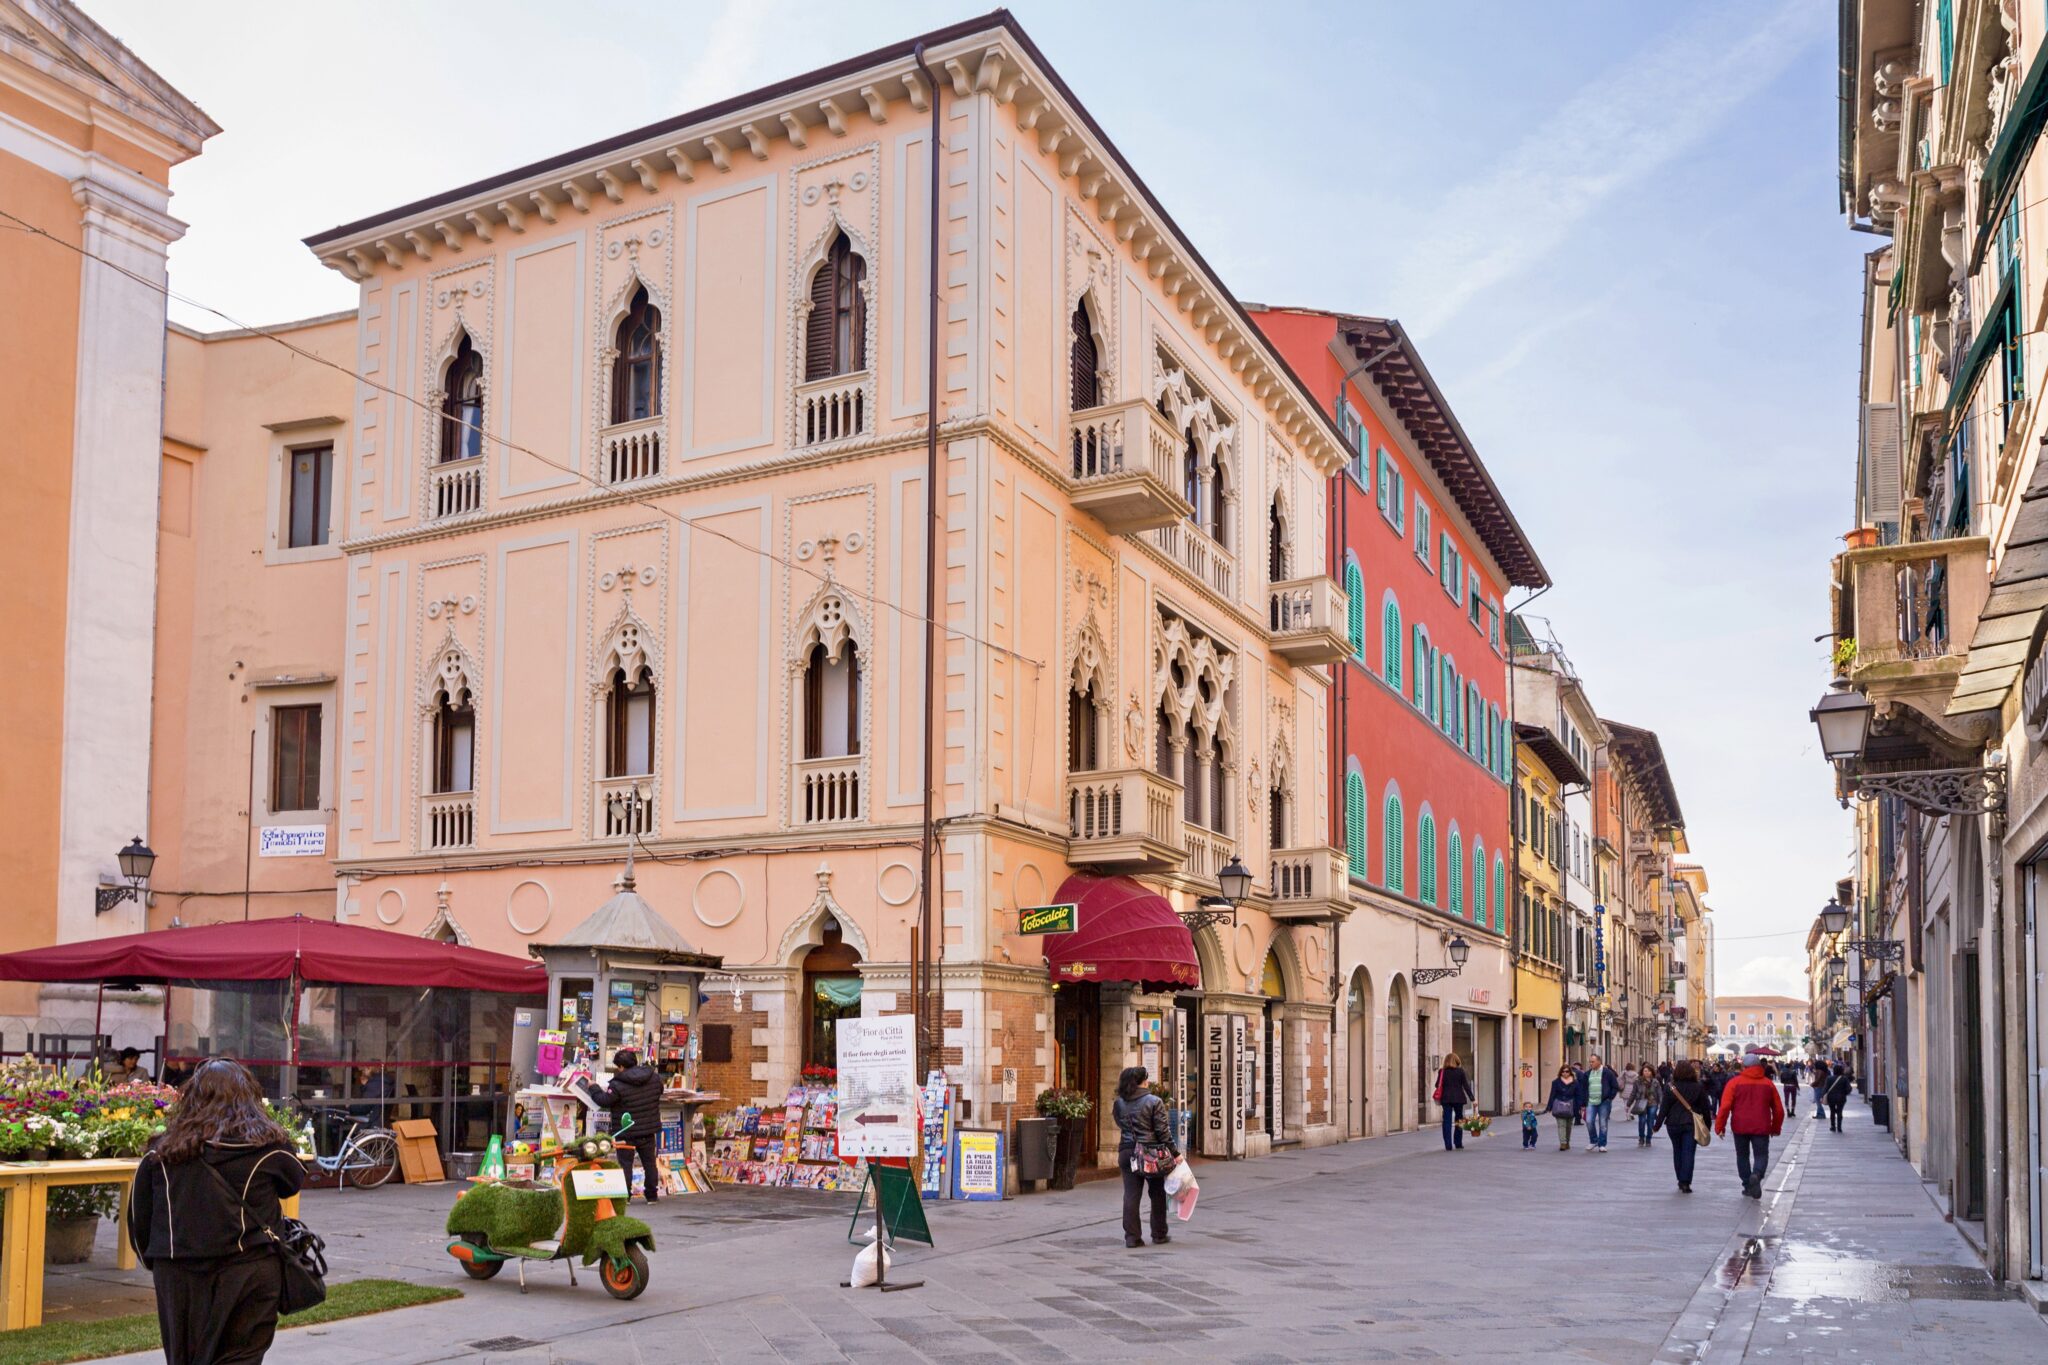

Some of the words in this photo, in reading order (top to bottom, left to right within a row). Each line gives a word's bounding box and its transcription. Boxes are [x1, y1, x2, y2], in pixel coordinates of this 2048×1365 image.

[1022, 907, 1069, 932] Totocalcio
[863, 1028, 877, 1037] Fior
[885, 1025, 903, 1035] Città
[873, 1049, 888, 1057] degli
[1274, 1045, 1281, 1058] 91
[1210, 1026, 1222, 1130] GABBRIELLINI
